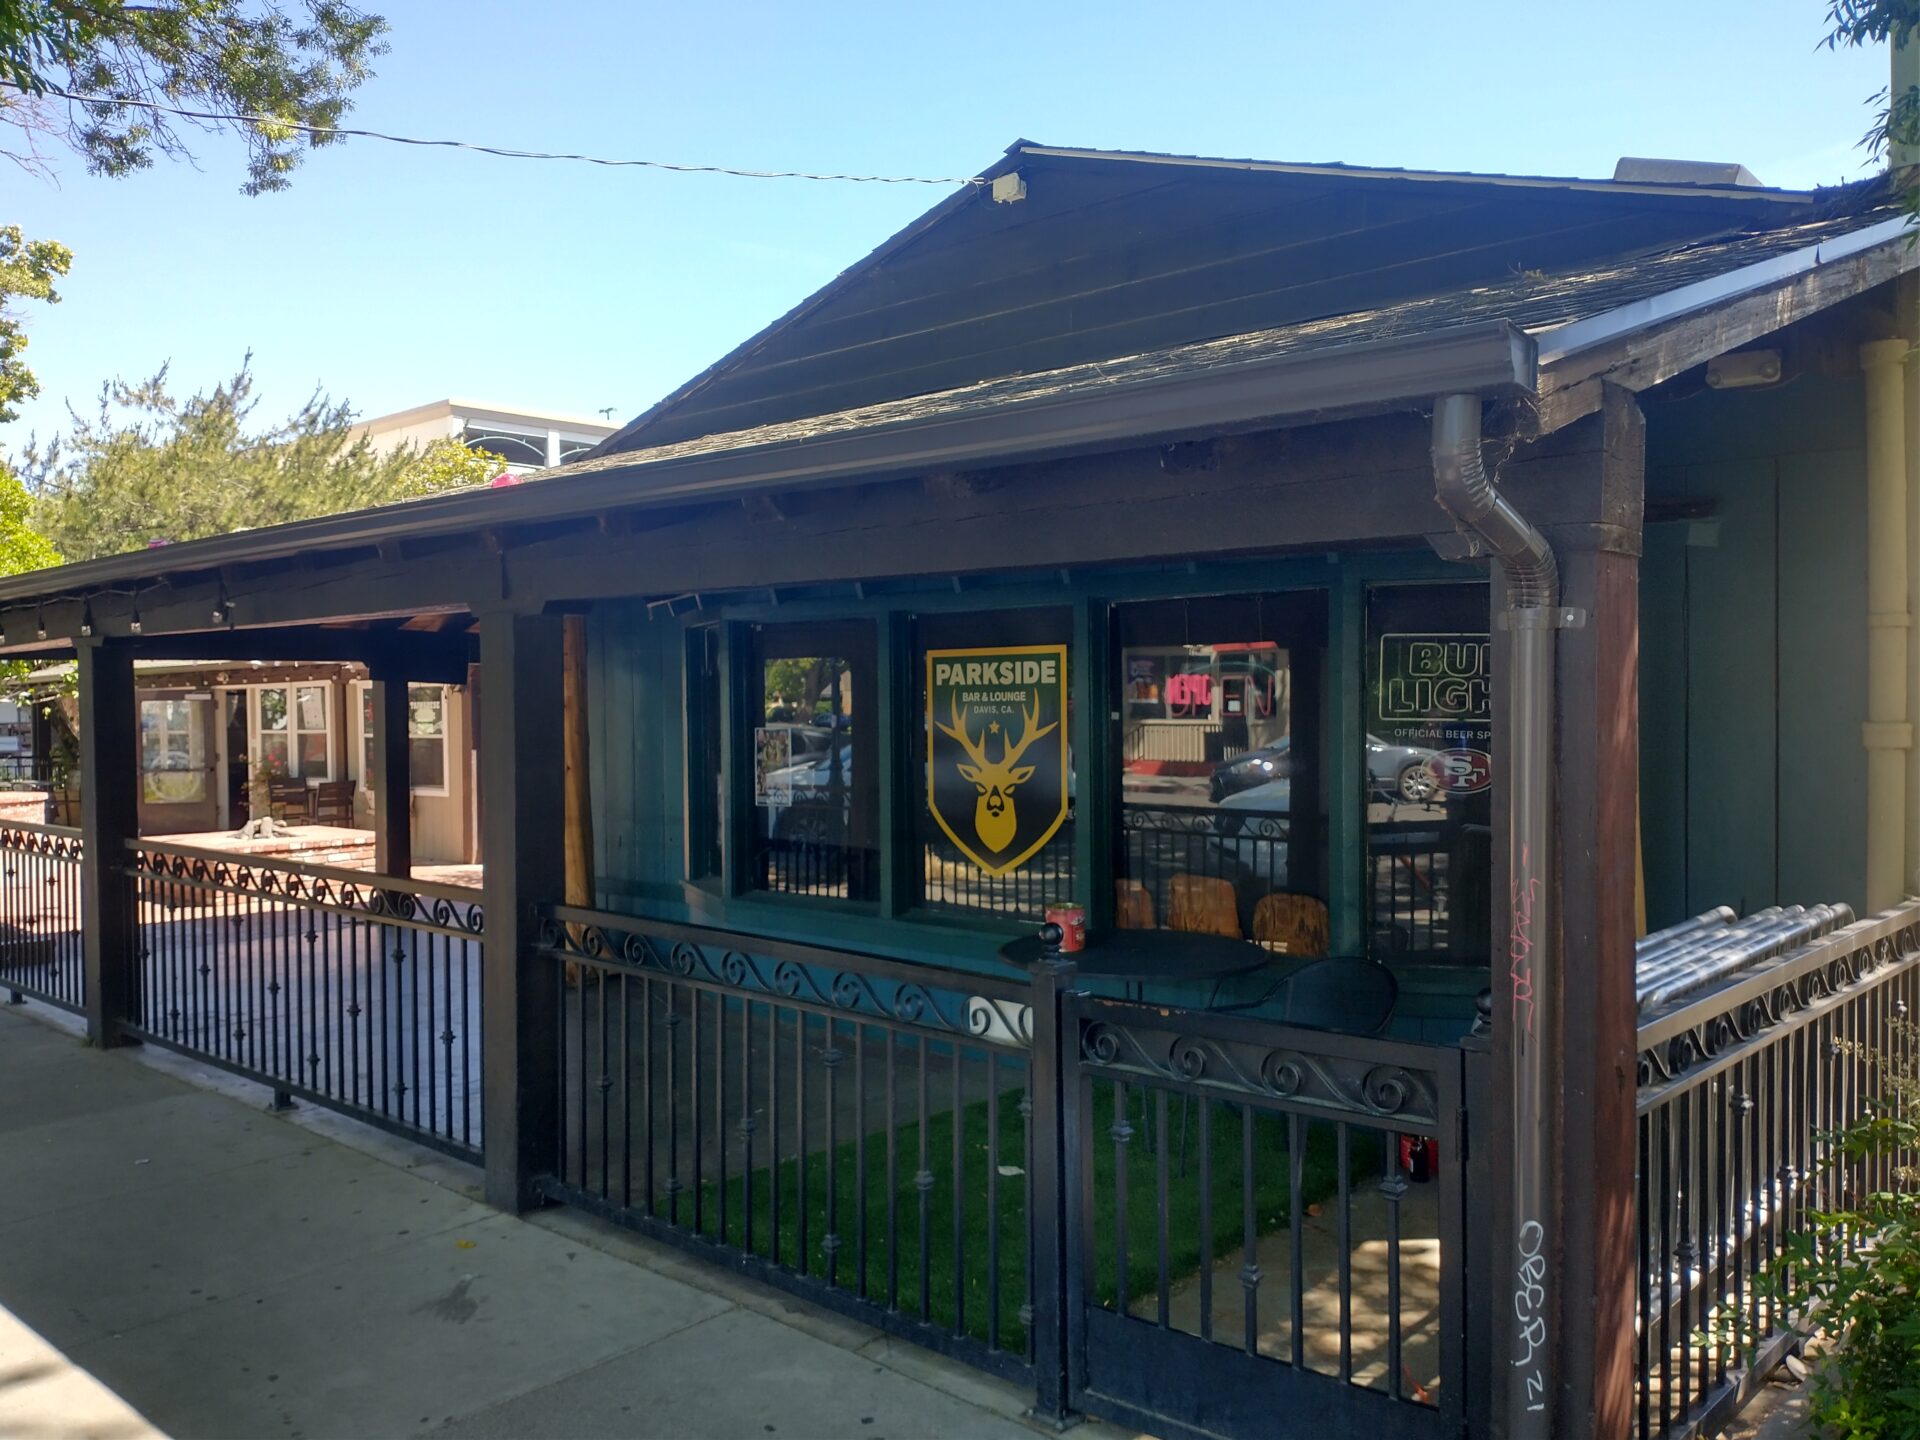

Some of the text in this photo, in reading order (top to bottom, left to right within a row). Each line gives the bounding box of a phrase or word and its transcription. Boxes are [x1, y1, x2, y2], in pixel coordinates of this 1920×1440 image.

[1409, 642, 1491, 677] BU
[936, 660, 1056, 686] PARKSIDE
[962, 691, 1027, 702] BAR & LOUNGE
[1000, 705, 1014, 714] CA.
[1394, 728, 1442, 739] OFFICIAL
[1445, 730, 1473, 739] BEER
[1444, 756, 1486, 787] SF
